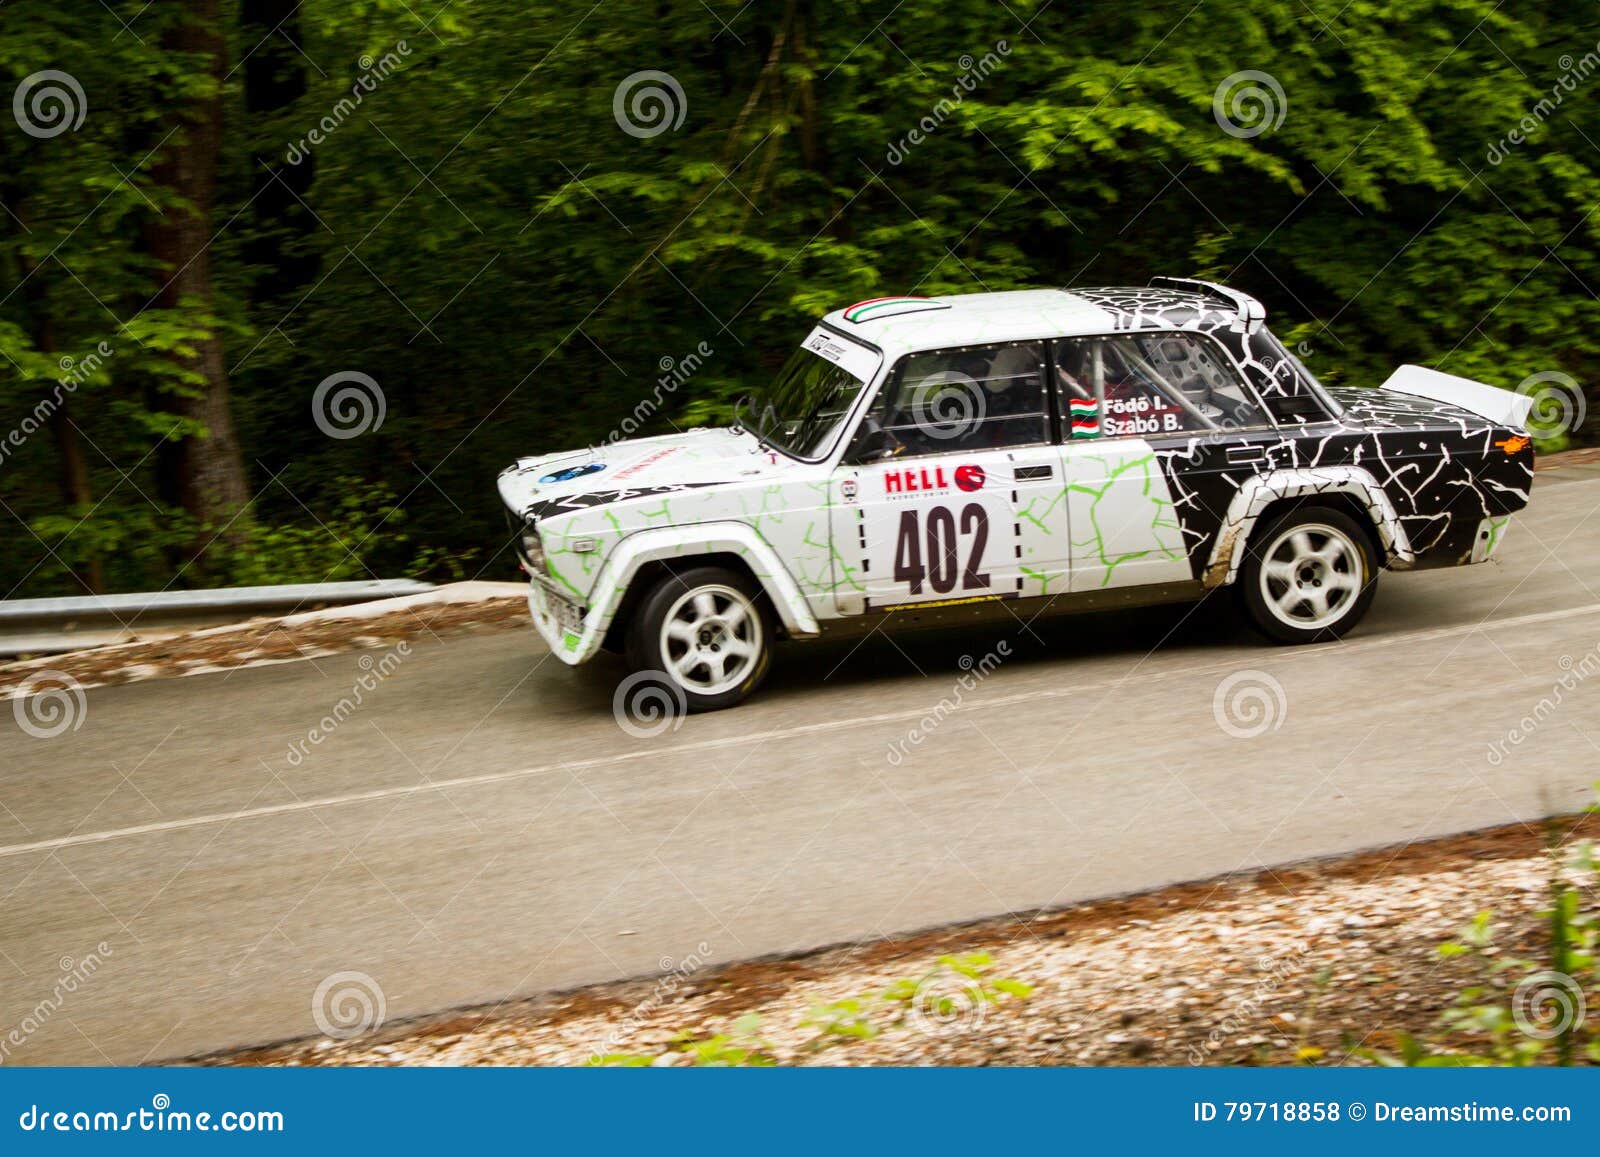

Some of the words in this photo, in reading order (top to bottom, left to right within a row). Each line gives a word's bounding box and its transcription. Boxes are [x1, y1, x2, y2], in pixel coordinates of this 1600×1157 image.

[1102, 396, 1150, 415] Födő
[1153, 395, 1168, 411] I.
[1103, 414, 1159, 436] Szabó
[1163, 413, 1184, 431] B.
[884, 465, 948, 493] HELL
[894, 502, 991, 595] 402
